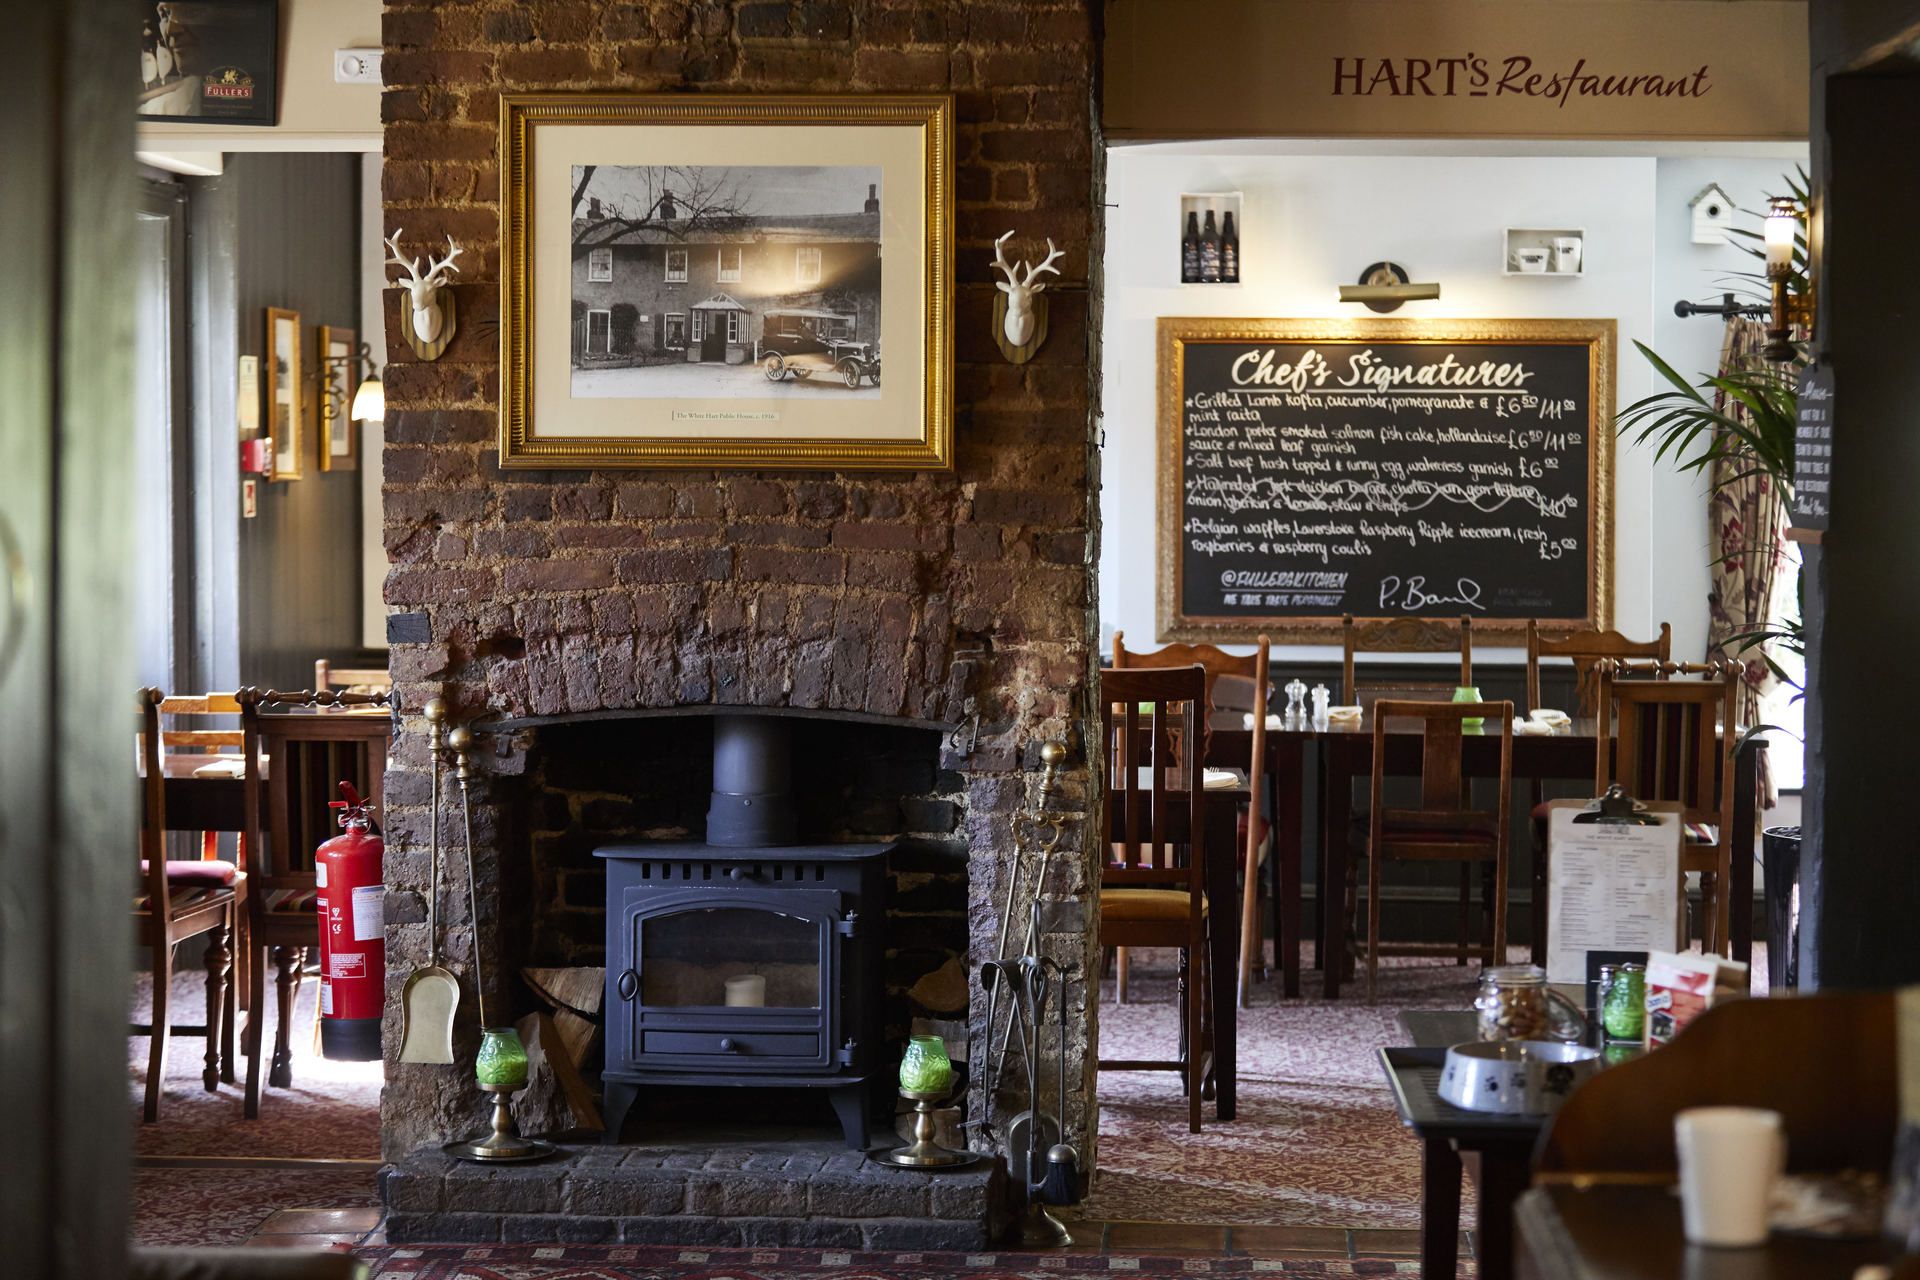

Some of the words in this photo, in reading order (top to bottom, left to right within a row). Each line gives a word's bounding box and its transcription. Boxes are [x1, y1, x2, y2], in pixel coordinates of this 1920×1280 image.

[1331, 52, 1490, 97] HART'S
[1496, 55, 1713, 108] Restaurant
[1231, 349, 1332, 393] Chef's
[1337, 349, 1535, 393] Signatures
[1189, 409, 1221, 423] mint
[1226, 409, 1262, 422] raita
[1194, 392, 1242, 408] Grilled
[1247, 393, 1282, 407] Lamb
[1392, 394, 1475, 415] pomegranate
[1193, 423, 1239, 437] London
[1245, 423, 1277, 442] porter
[1281, 424, 1328, 439] smoked
[1331, 424, 1376, 440] salmon
[1380, 425, 1403, 444] fish
[1188, 441, 1224, 451] sauce
[1238, 440, 1275, 452] mixed
[1280, 439, 1304, 455] leaf
[1310, 441, 1357, 459] garnish
[1194, 453, 1223, 468] Salt
[1228, 454, 1254, 474] beef
[1258, 455, 1289, 471] hash
[1292, 457, 1331, 476] topped
[1346, 460, 1380, 480] runny
[1468, 462, 1513, 481] garnish
[1191, 517, 1238, 540] Belgian
[1359, 519, 1416, 547] Raspberry
[1418, 519, 1455, 543] Ripple
[1517, 524, 1548, 544] fresh
[1191, 539, 1255, 558] raspberries
[1272, 540, 1328, 564] raspberry
[1331, 539, 1373, 555] coulis
